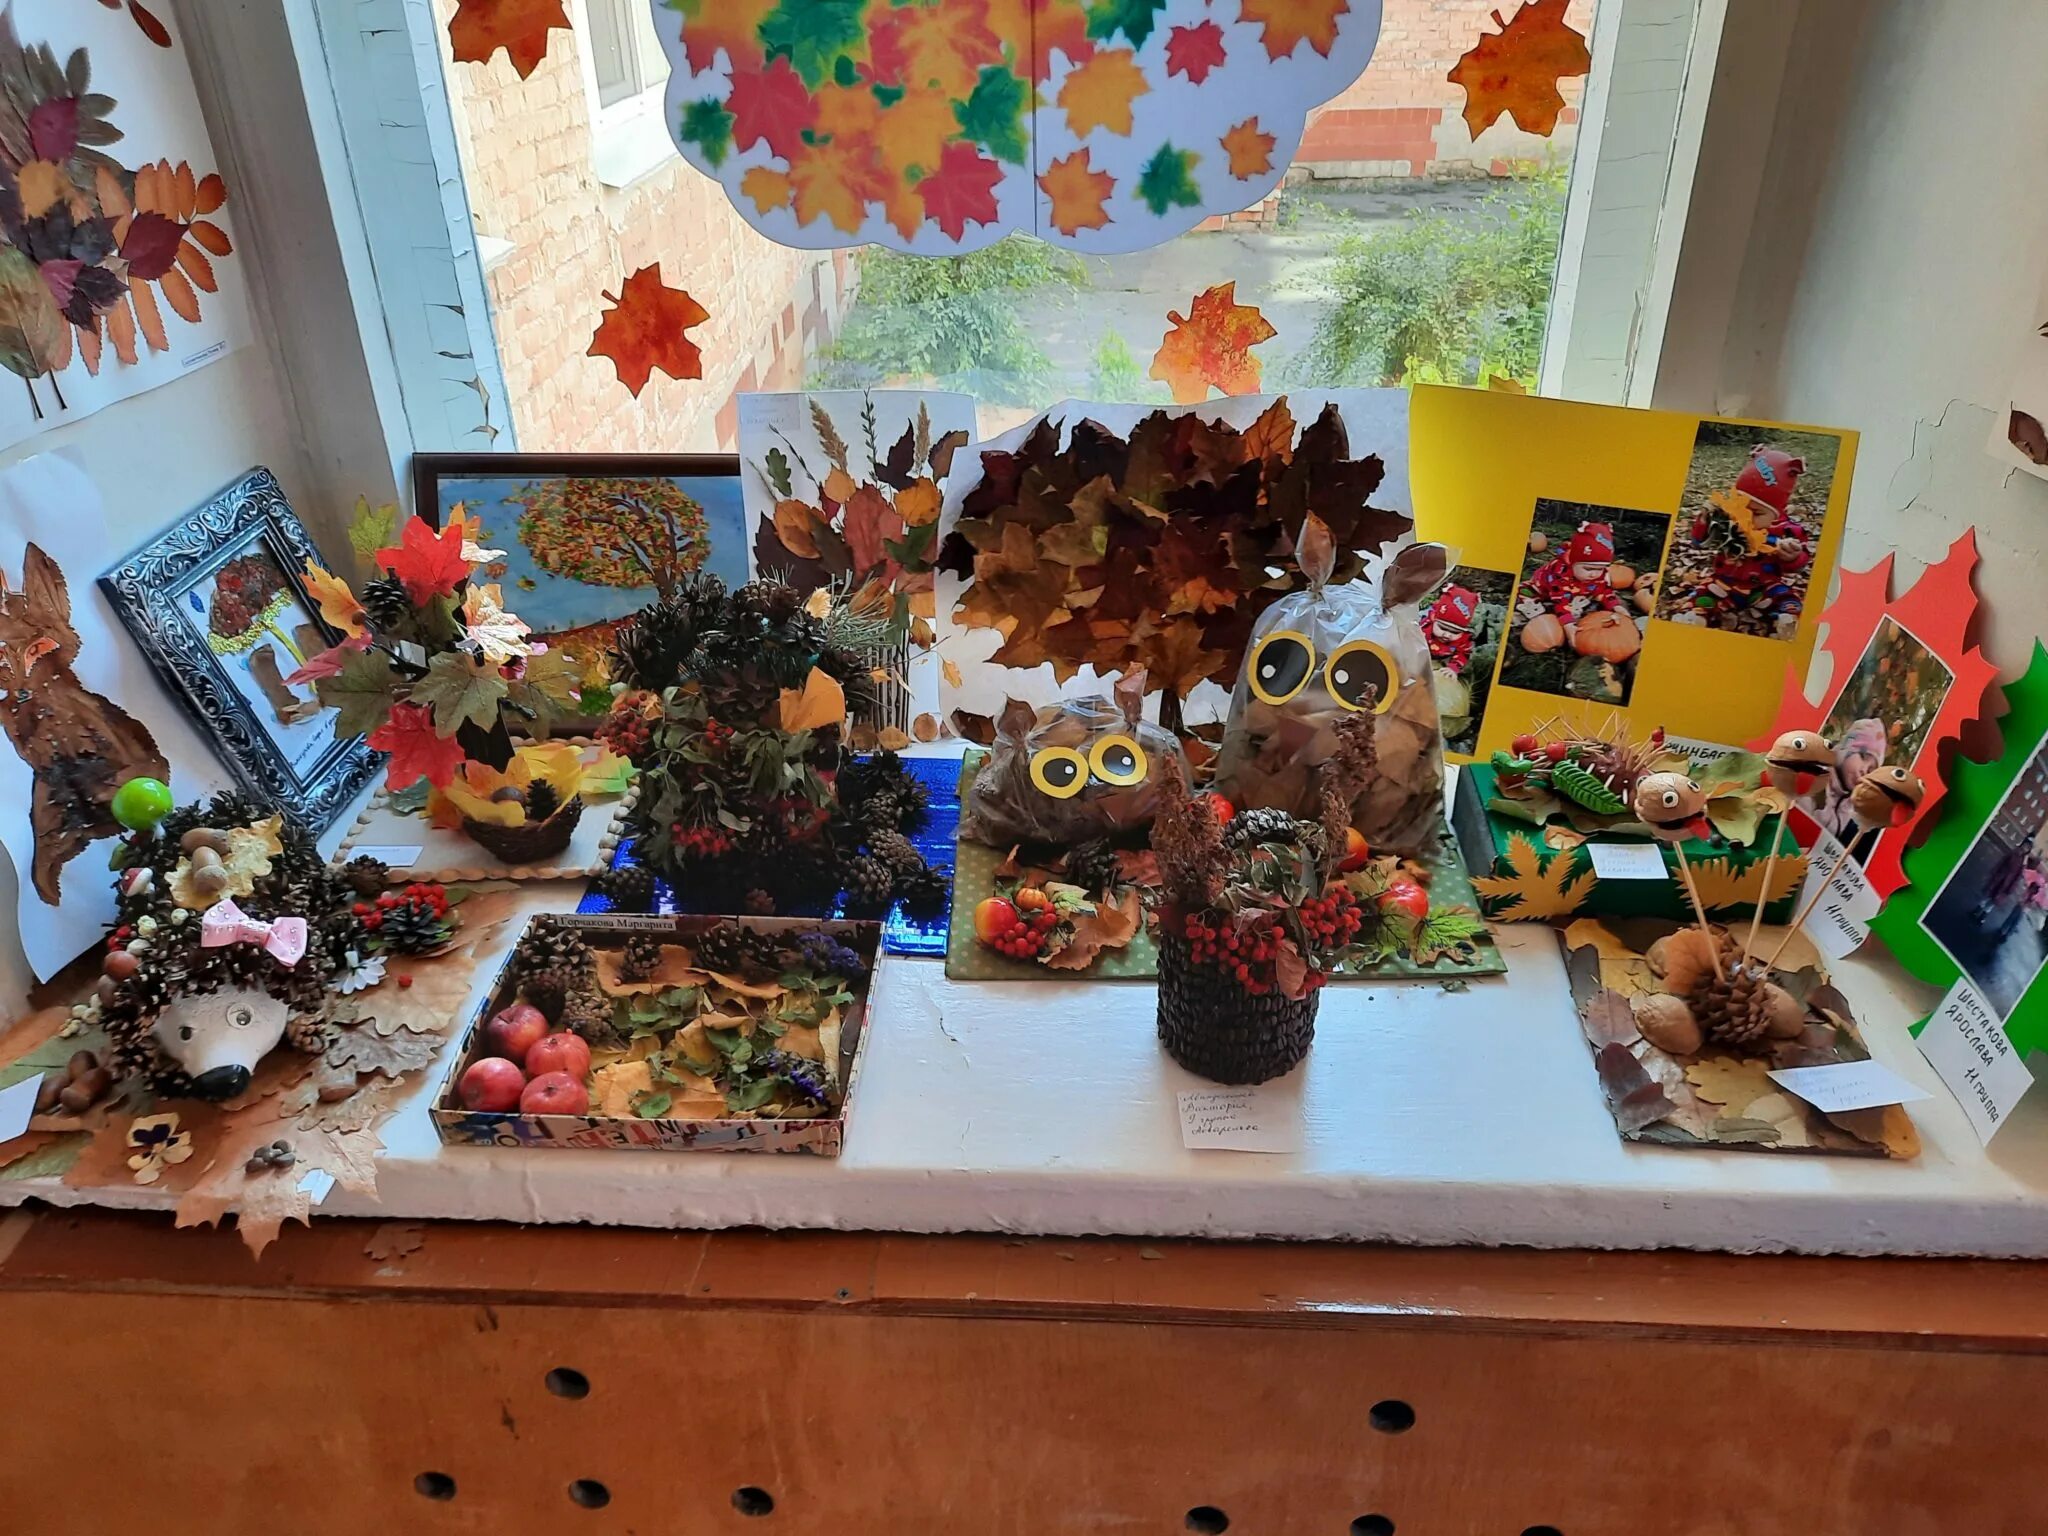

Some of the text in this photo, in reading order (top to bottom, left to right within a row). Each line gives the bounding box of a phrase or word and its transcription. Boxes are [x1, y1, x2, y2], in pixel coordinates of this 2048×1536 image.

[1811, 856, 1853, 902] ЯРОЛАВА
[560, 916, 674, 930] Горчакова Маргарита
[1945, 1004, 1994, 1067] ЯРОСЛАВА
